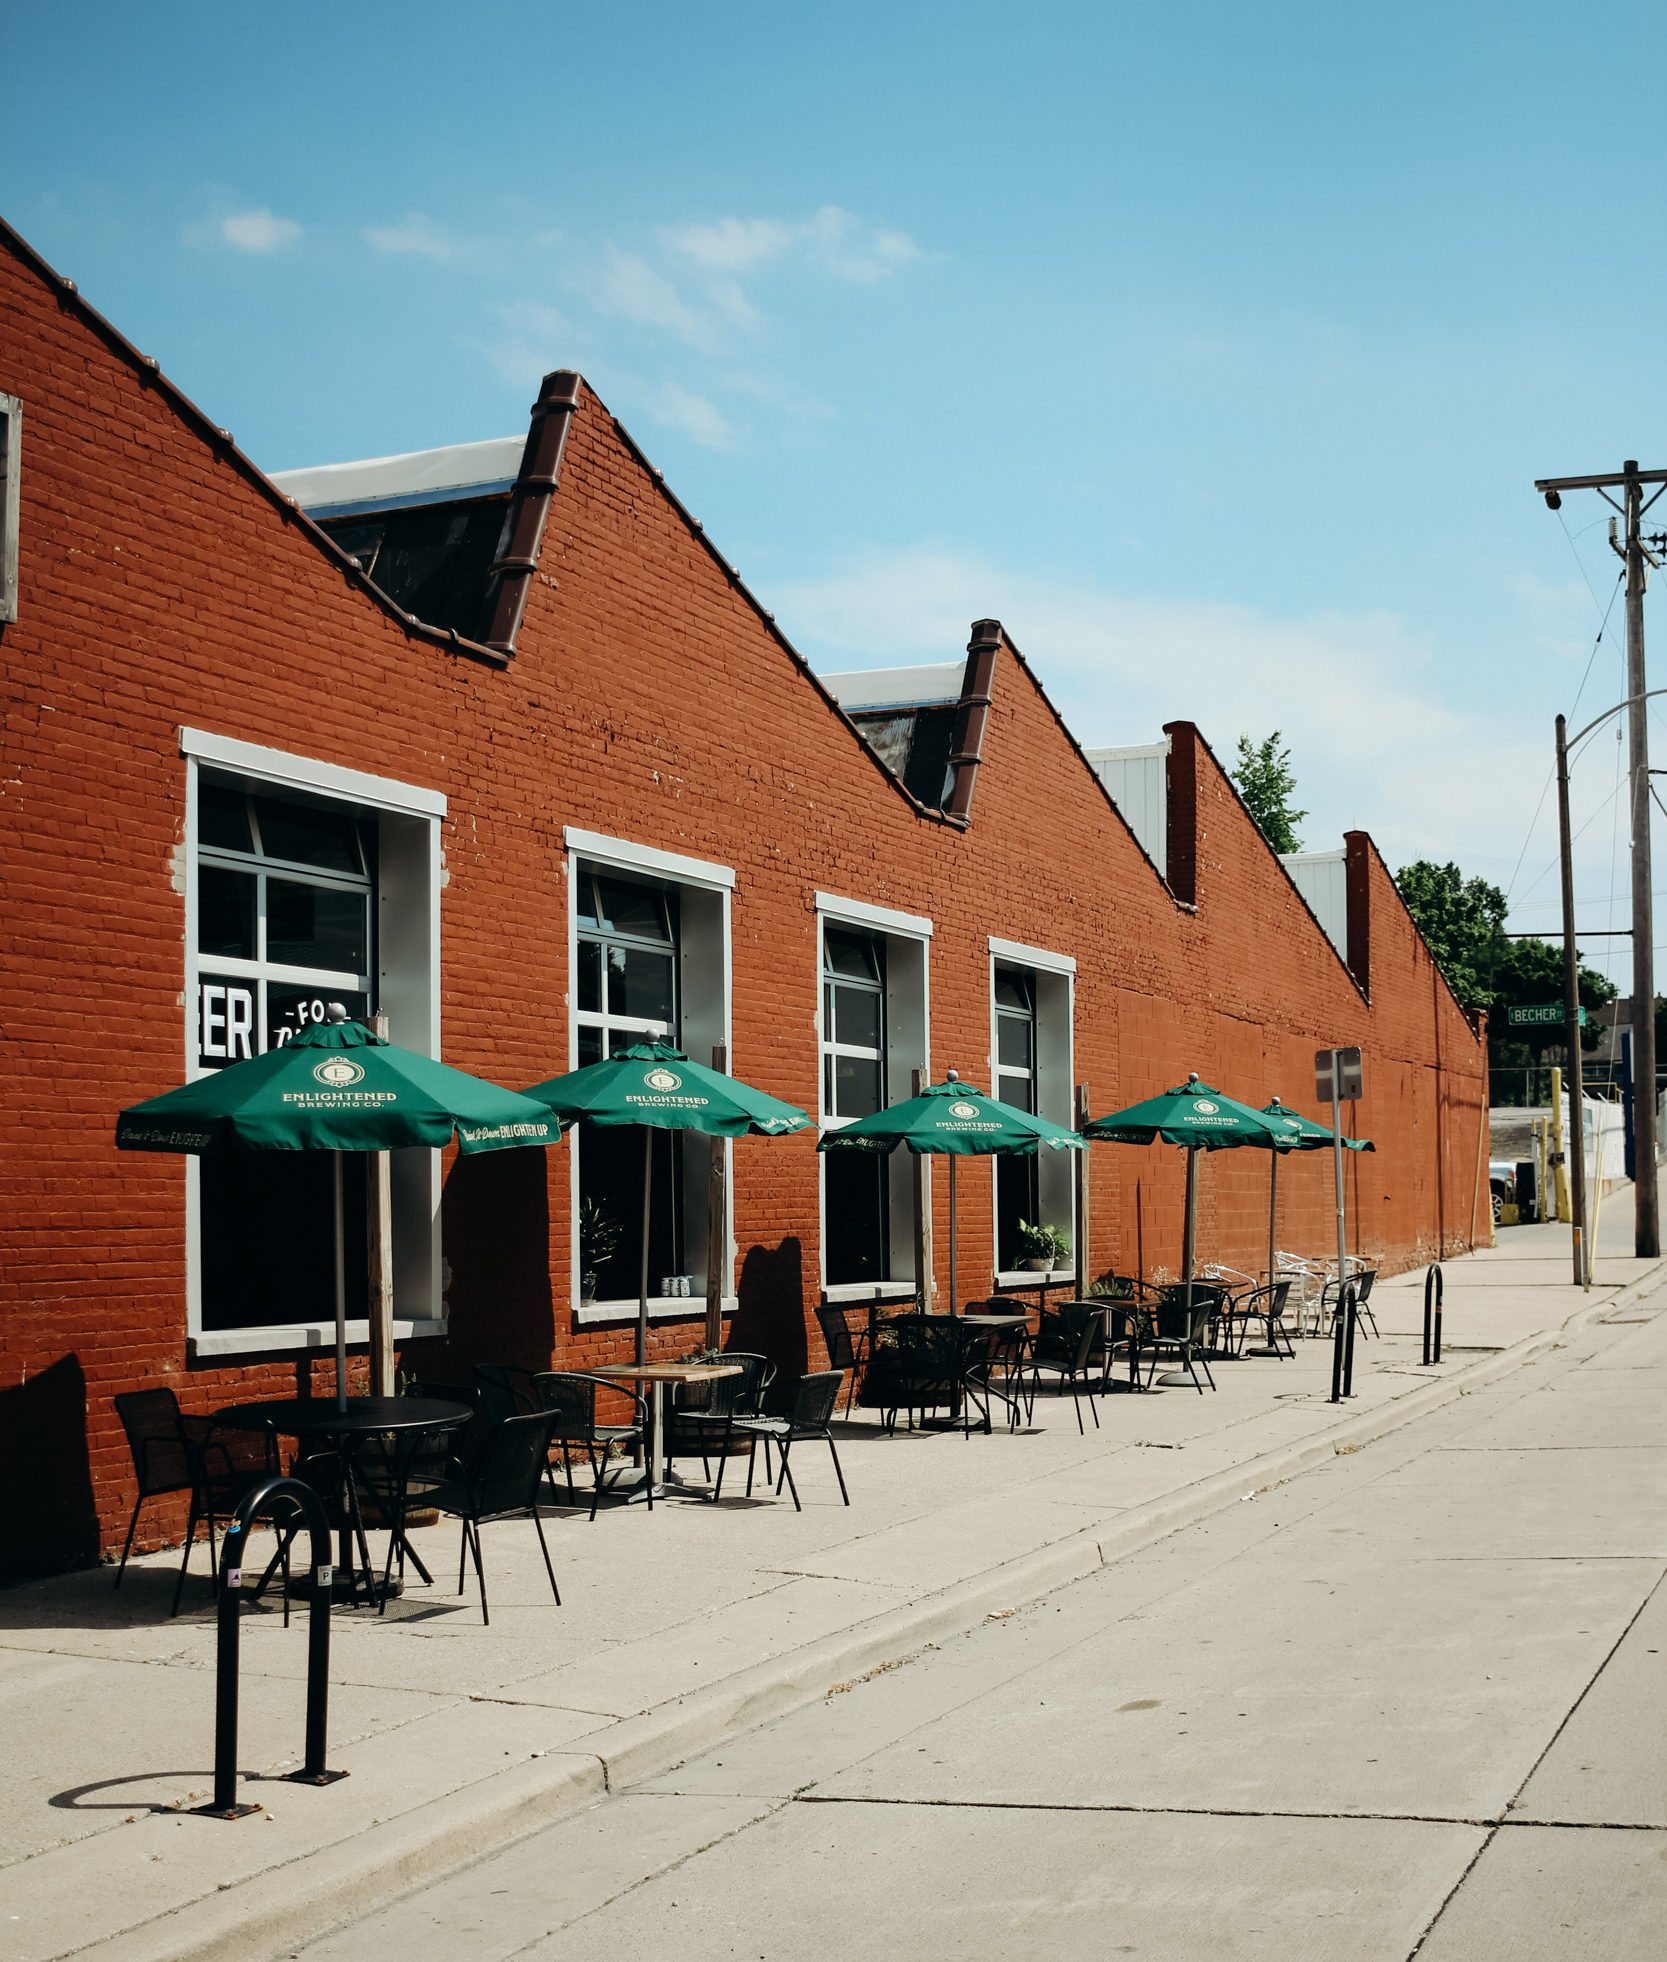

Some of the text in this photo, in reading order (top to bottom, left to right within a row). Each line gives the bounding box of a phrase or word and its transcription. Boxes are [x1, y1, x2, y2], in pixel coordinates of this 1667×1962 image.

[1514, 1008, 1557, 1022] BECHER
[199, 984, 253, 1060] ER
[334, 1067, 345, 1079] E
[282, 1092, 398, 1102] ENLIGHTENED
[625, 1095, 710, 1105] ENLIGHTENED
[1183, 1116, 1240, 1124] ENLIGHTENED
[499, 1124, 538, 1139] ENLIGHTEN
[537, 1123, 549, 1136] UP
[323, 1572, 330, 1580] P
